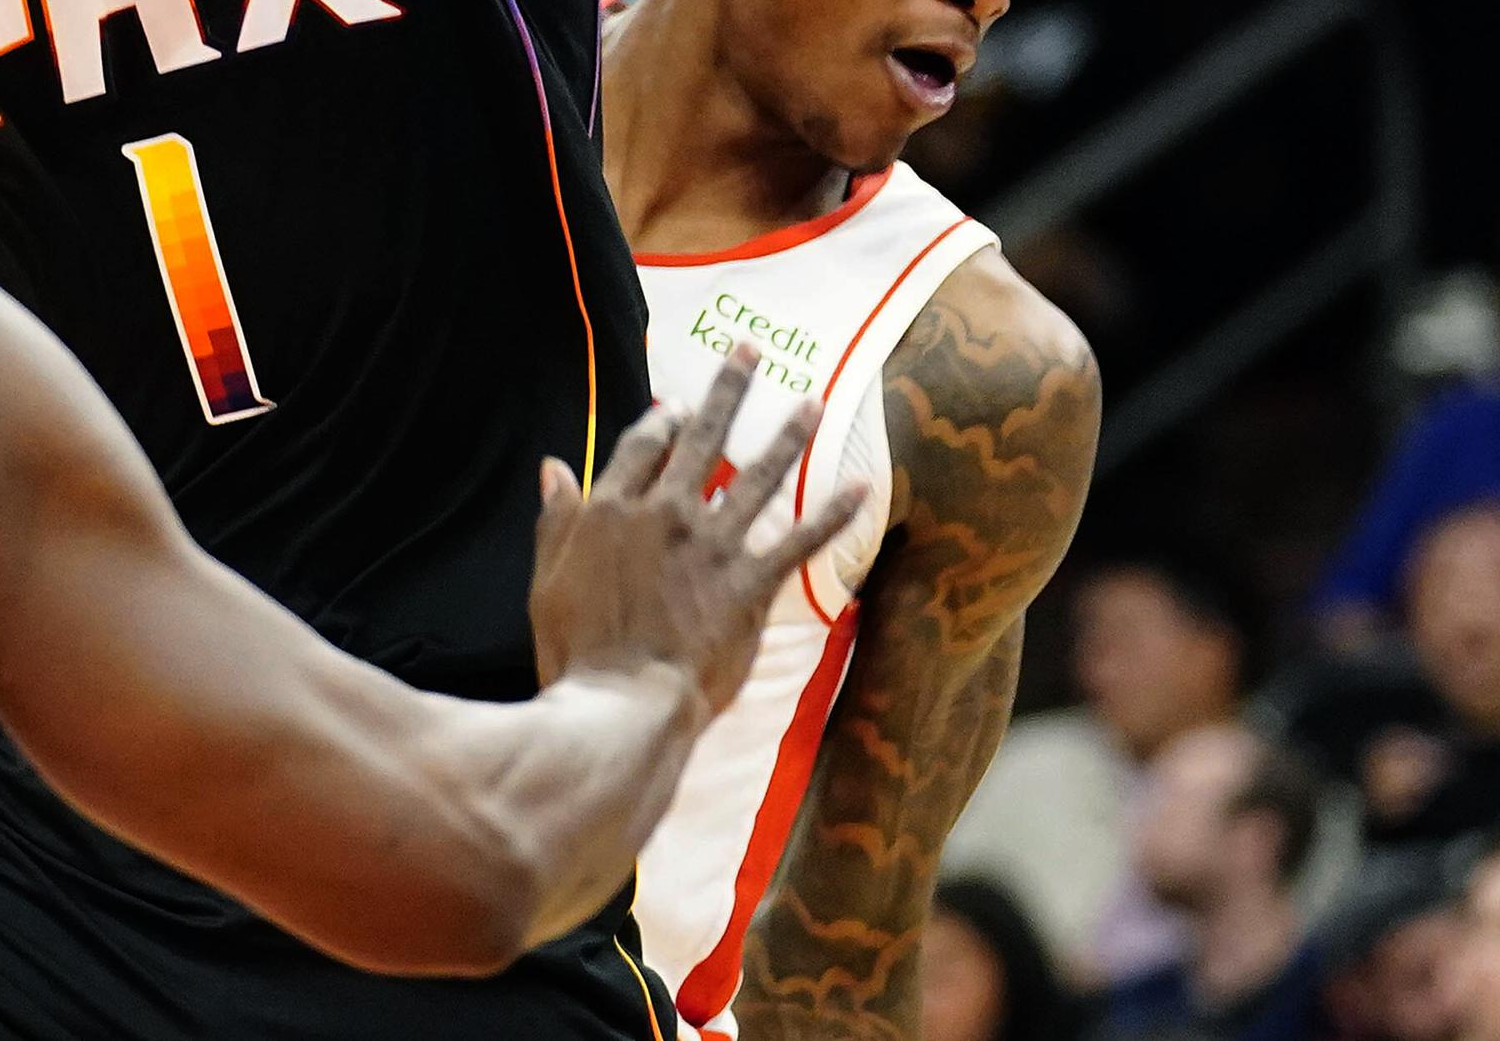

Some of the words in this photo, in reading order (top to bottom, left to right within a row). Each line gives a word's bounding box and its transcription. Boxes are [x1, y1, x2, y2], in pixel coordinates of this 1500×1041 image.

[121, 132, 277, 426] 1
[690, 309, 812, 394] kama
[716, 293, 821, 365] credit
